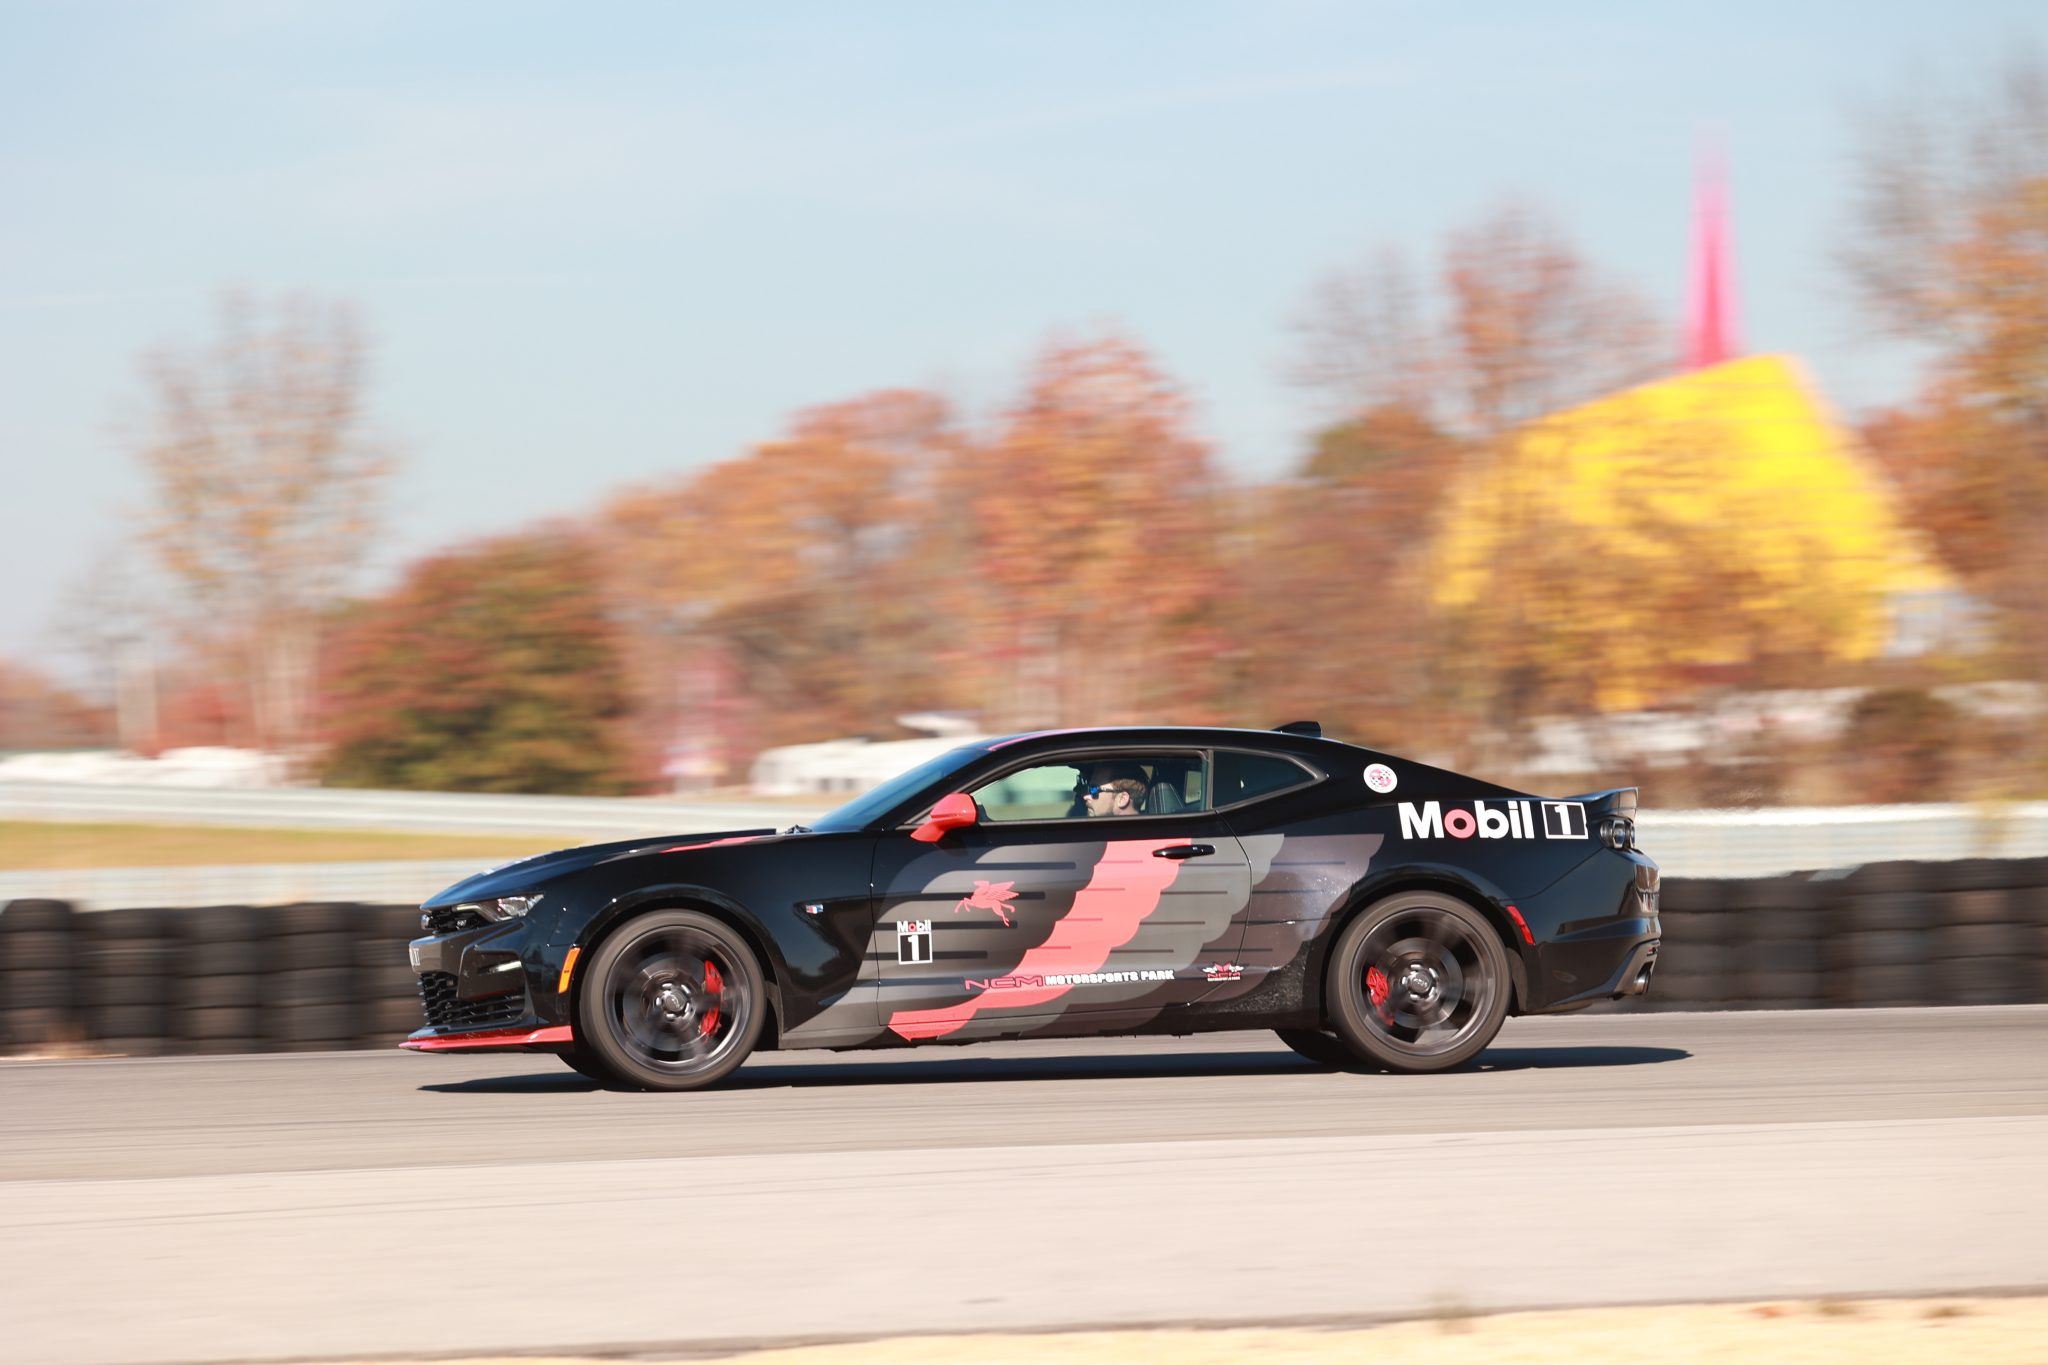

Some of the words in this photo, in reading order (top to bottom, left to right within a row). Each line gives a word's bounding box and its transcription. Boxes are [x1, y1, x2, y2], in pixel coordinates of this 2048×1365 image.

[1398, 800, 1535, 839] Mobil
[896, 919, 931, 932] Mobil
[965, 975, 1044, 990] NCM
[1045, 972, 1138, 986] MOTORSPORTS
[1140, 969, 1175, 981] PARK
